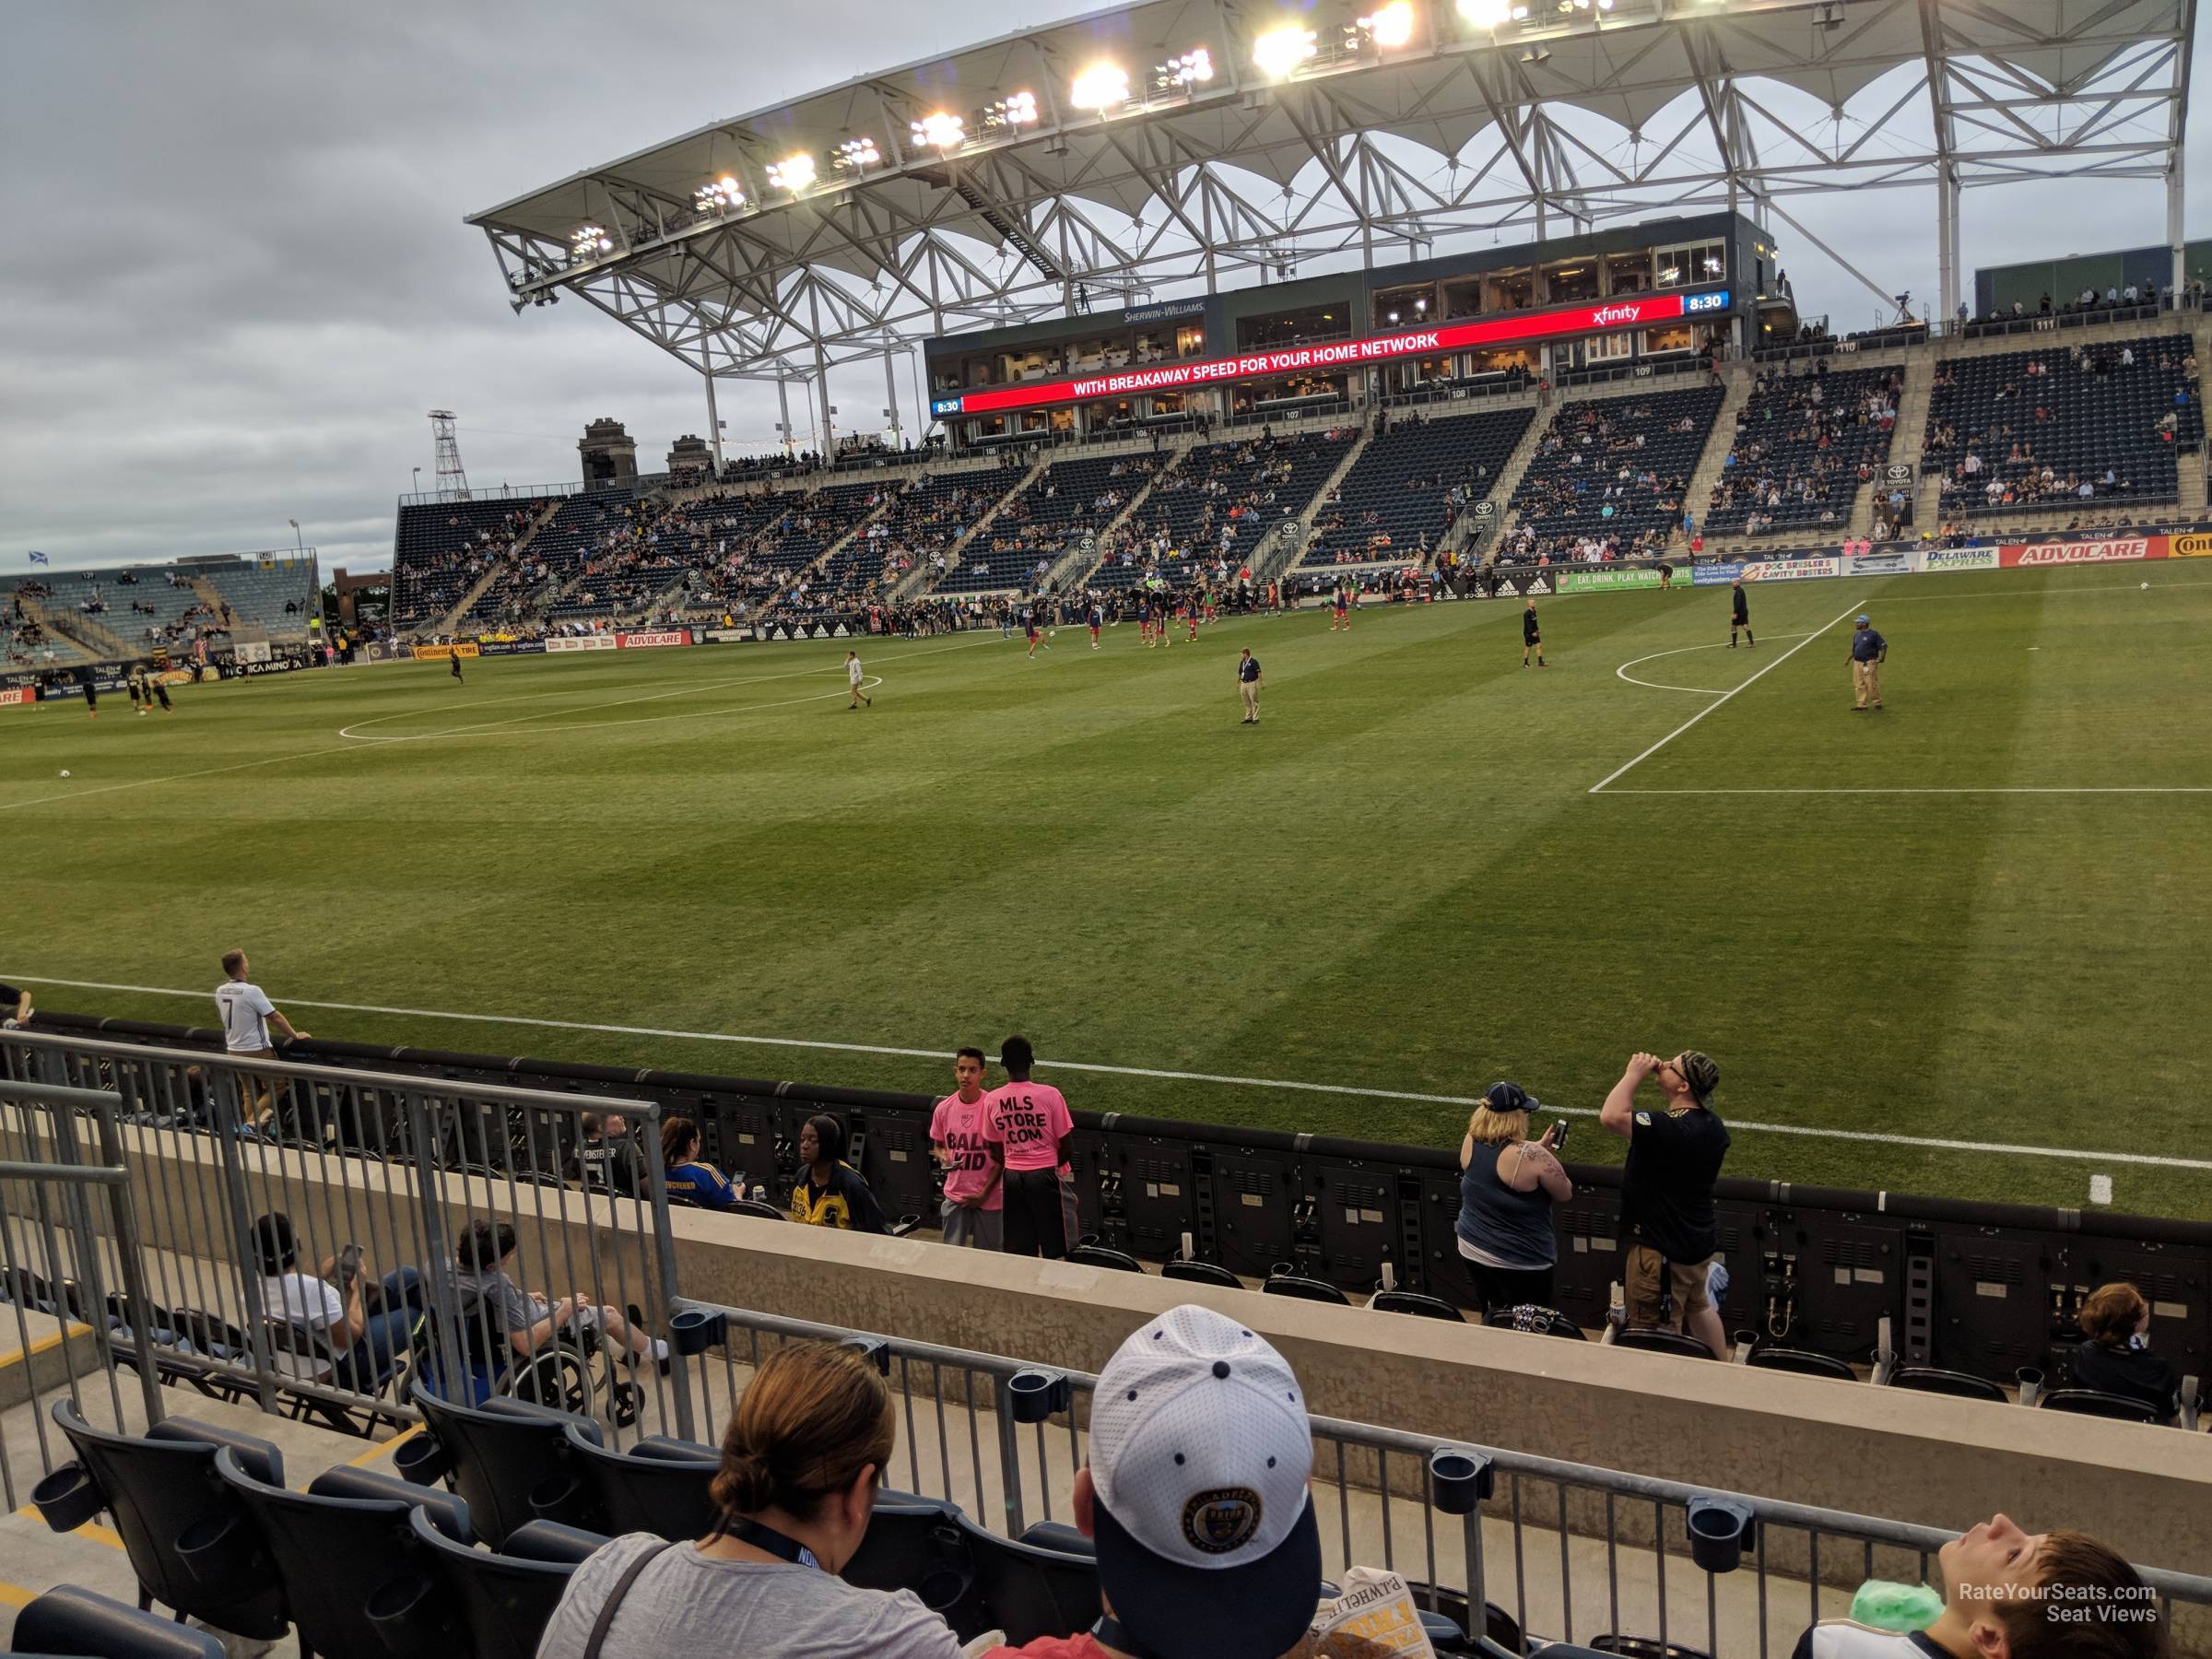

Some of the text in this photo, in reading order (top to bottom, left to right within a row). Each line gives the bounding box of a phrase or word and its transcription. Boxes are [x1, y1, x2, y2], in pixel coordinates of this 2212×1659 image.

[1689, 295, 1722, 310] 8:30
[1124, 302, 1204, 323] SHERWIN-WILLIAMS
[1593, 305, 1641, 324] xfinity
[2036, 320, 2053, 330] 111
[1839, 342, 1856, 352] 110
[1074, 333, 1440, 395] WITH BREAKAWAY SPEED FOR YOUR HOME NETWORK
[1635, 367, 1651, 376] 109
[1452, 389, 1465, 399] 108
[937, 403, 959, 413] 8:30
[1286, 410, 1300, 419] 107
[1135, 429, 1147, 438] 106
[985, 447, 997, 456] 105
[771, 471, 781, 479] 103
[2159, 527, 2186, 535] TALEN
[1995, 537, 2019, 546] TALEN
[1926, 549, 1993, 561] DELAWARE
[2019, 540, 2147, 564] ADVOCARE
[1765, 560, 1783, 570] DOC
[1926, 557, 1994, 570] EXPRESS
[1637, 571, 1660, 581] WATCH
[1762, 566, 1833, 579] CAVITY BUSTERS
[1495, 589, 1520, 597] adidas
[626, 633, 681, 647] ADVOCARE
[461, 646, 477, 654] TIRE
[222, 998, 233, 1030] 7
[999, 1095, 1034, 1112] MLS
[994, 1112, 1047, 1131] STORE
[1006, 1127, 1043, 1145] .COM
[953, 1153, 986, 1171] KID
